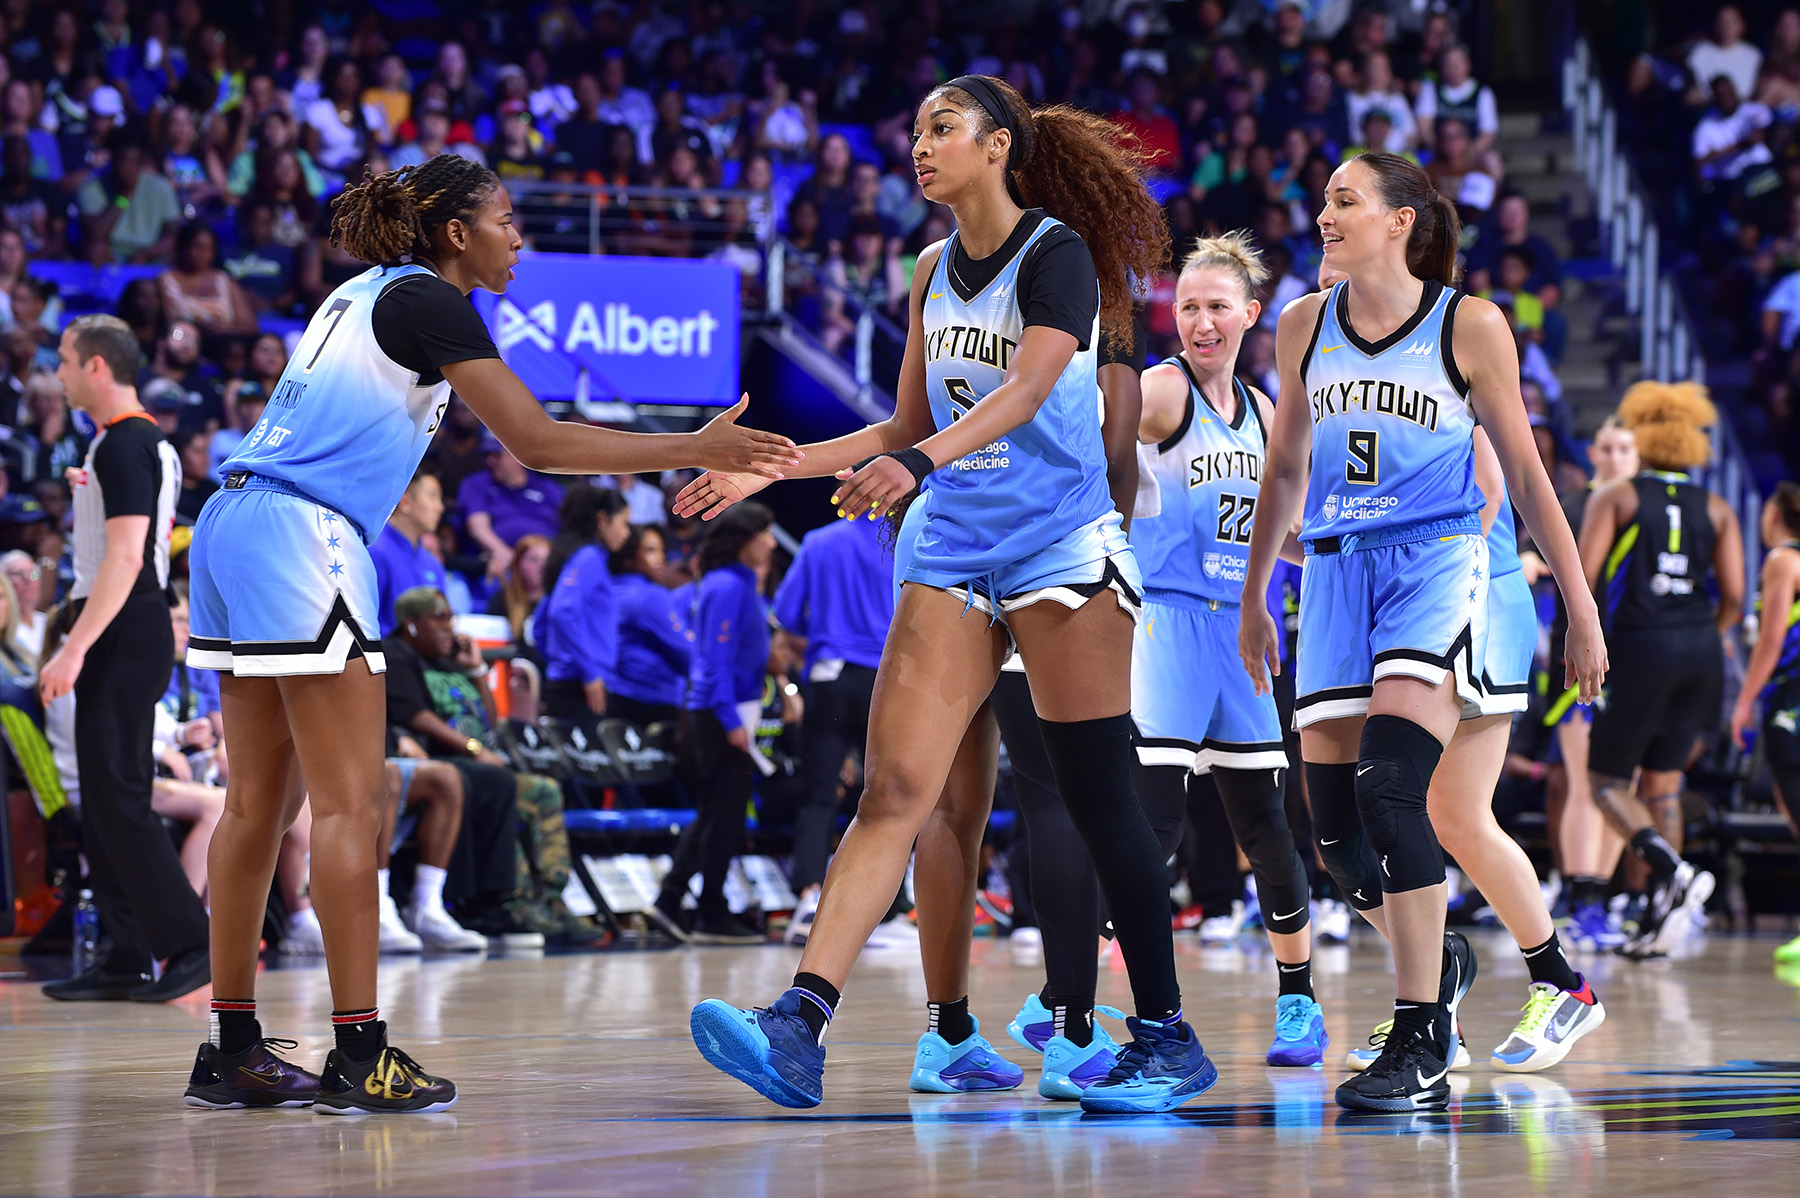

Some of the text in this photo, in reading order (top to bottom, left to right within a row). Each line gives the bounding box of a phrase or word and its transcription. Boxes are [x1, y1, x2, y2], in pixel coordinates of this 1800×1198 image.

[305, 297, 353, 374] 7
[564, 301, 720, 358] Albert
[924, 326, 1018, 372] KYTOWN
[943, 376, 977, 423] 5
[1312, 379, 1439, 433] SKYTOWN
[951, 455, 1010, 471] Medicine
[1189, 450, 1264, 488] SKYTO
[1345, 429, 1379, 486] 9
[1215, 491, 1258, 546] 22
[1665, 503, 1682, 553] 1
